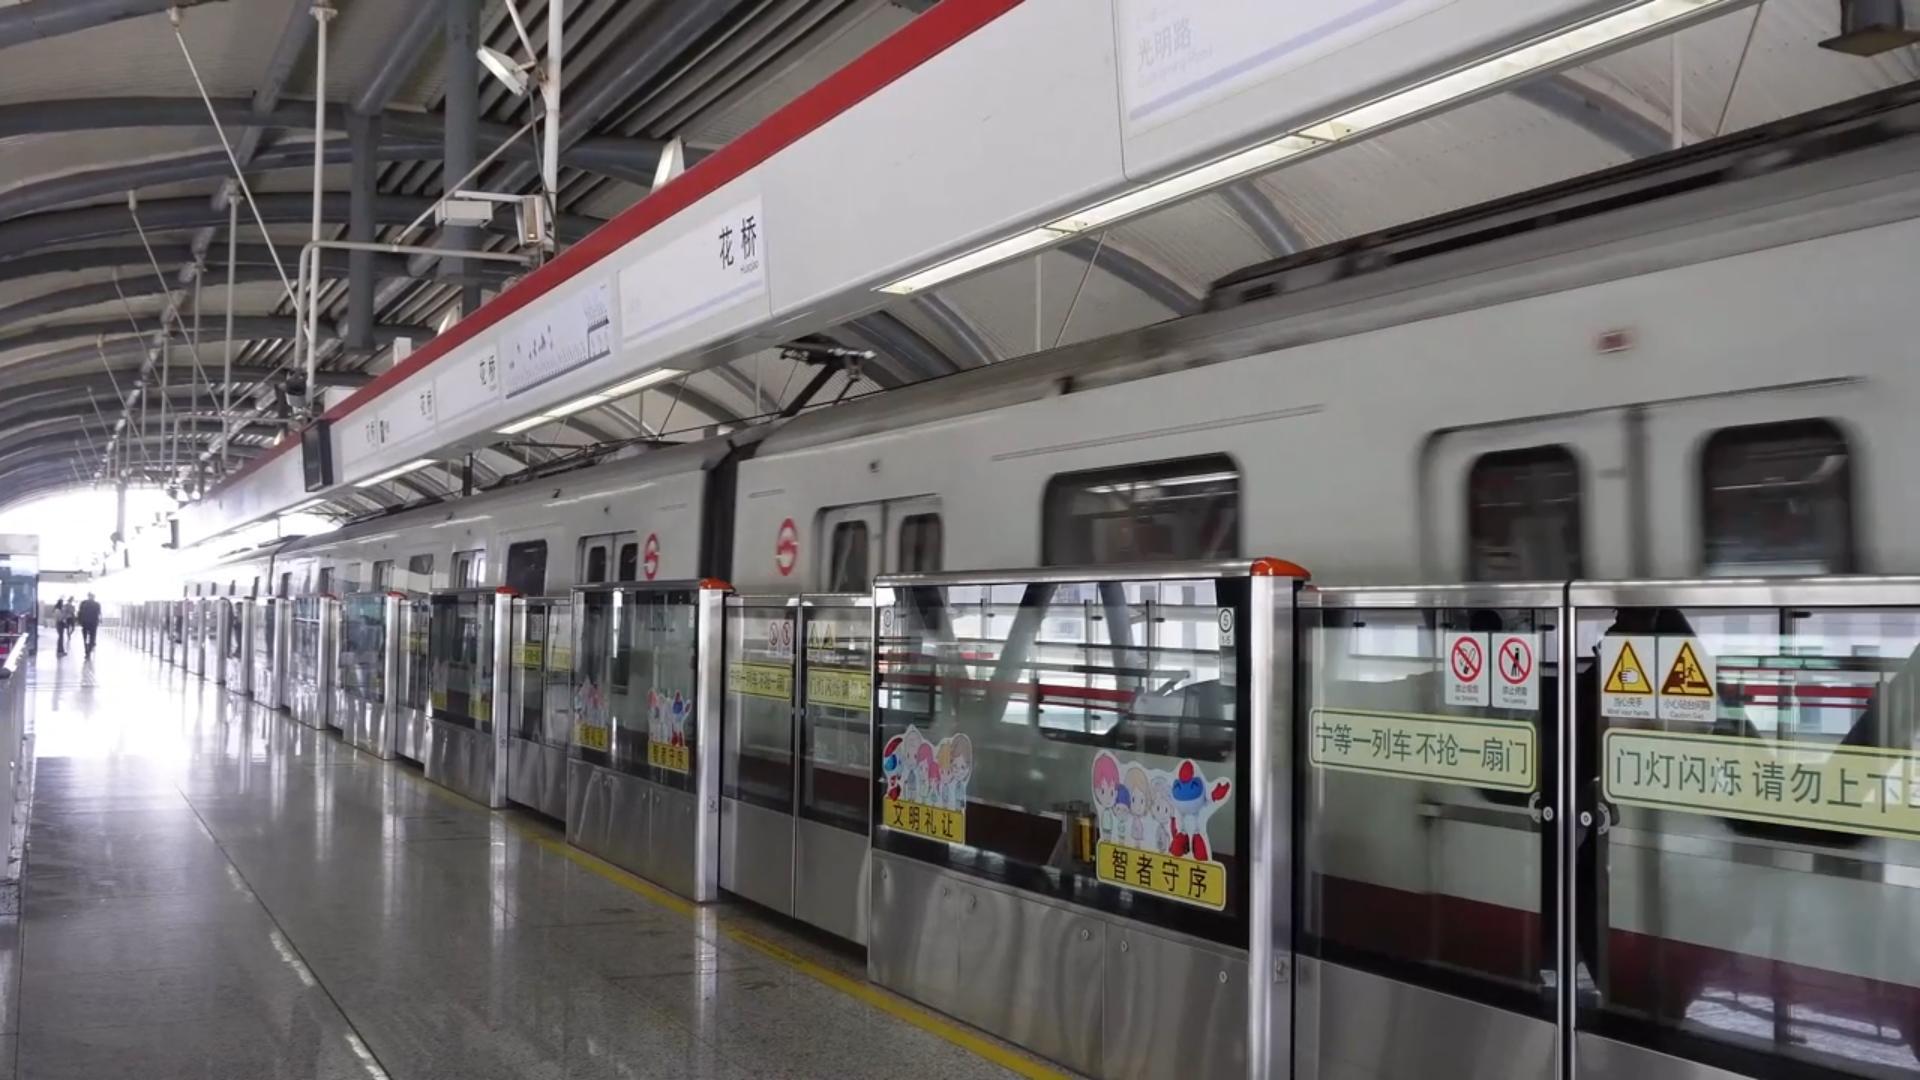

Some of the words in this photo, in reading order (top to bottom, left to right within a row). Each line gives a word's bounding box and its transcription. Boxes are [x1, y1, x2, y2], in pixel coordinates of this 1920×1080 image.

[1137, 17, 1191, 72] 光明路
[719, 215, 757, 270] 花桥
[892, 802, 953, 838] 文明礼让
[1111, 847, 1208, 898] 智者守序
